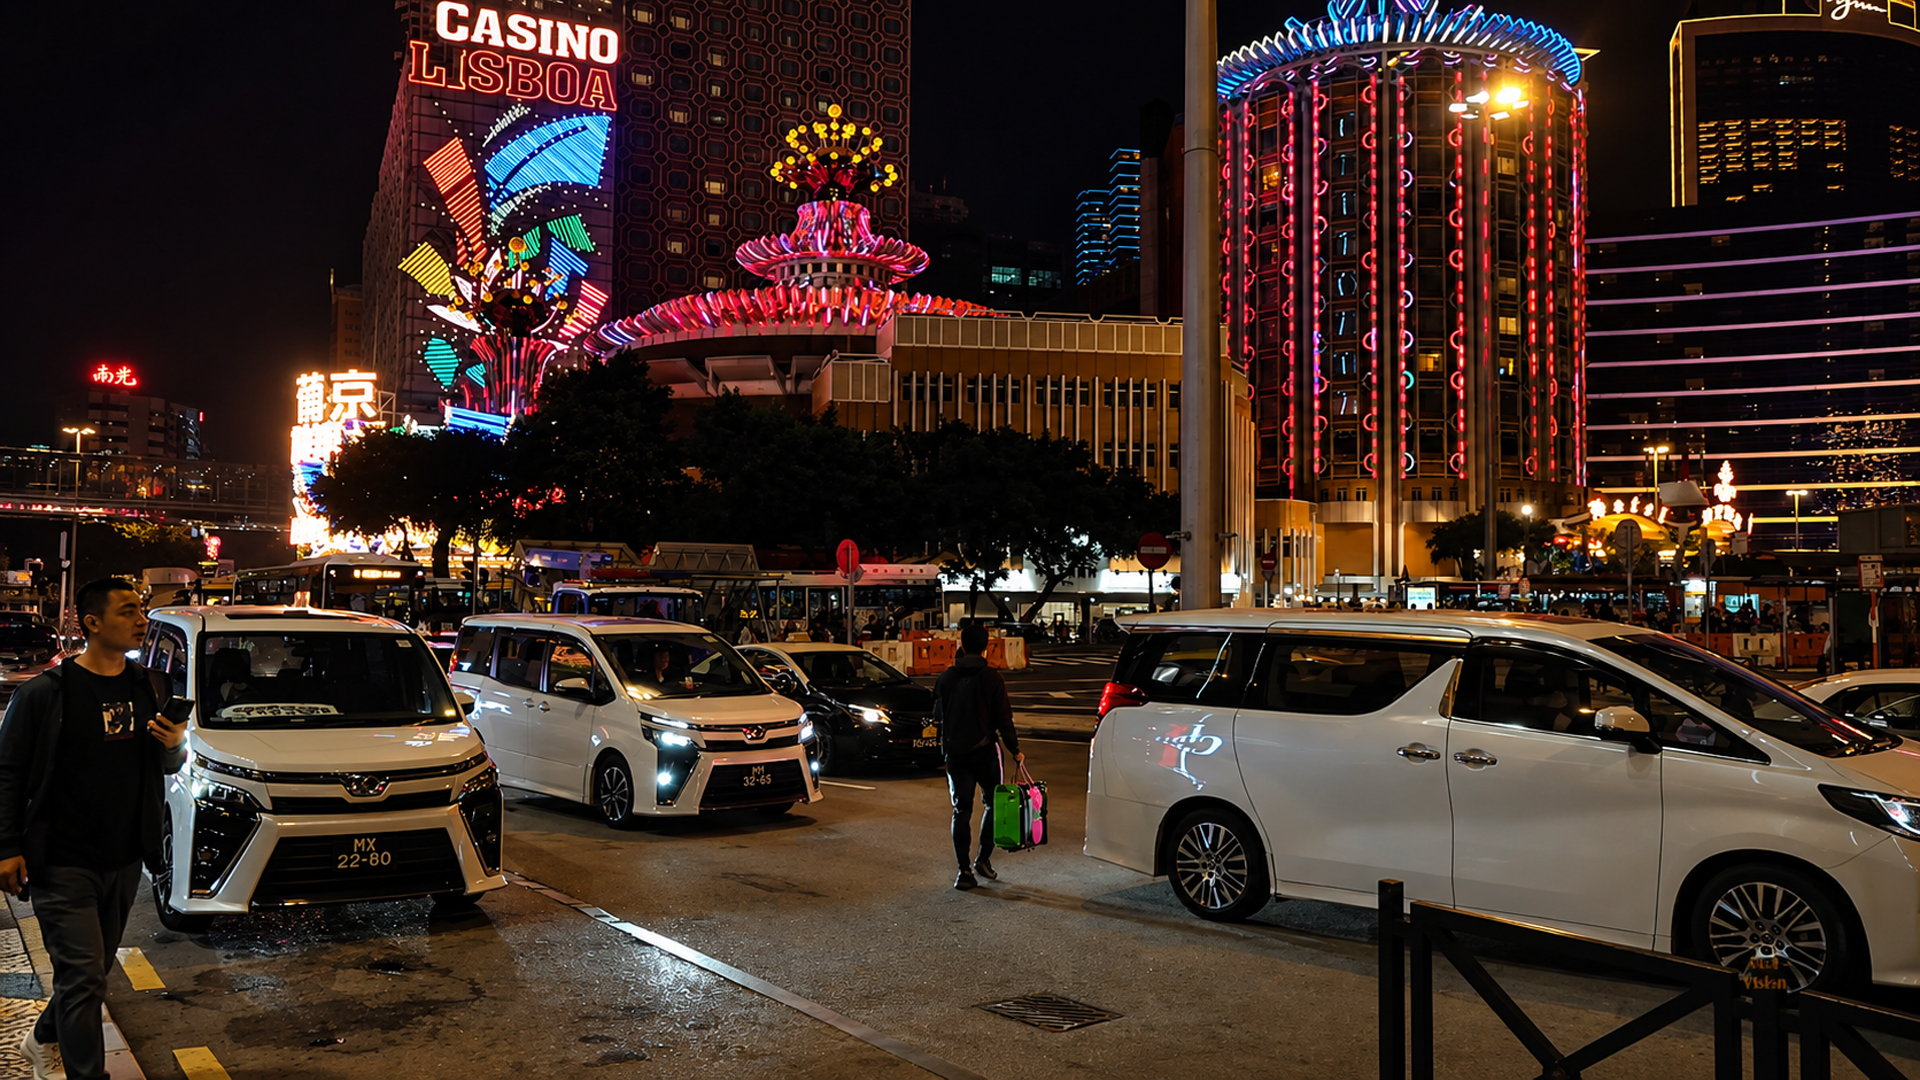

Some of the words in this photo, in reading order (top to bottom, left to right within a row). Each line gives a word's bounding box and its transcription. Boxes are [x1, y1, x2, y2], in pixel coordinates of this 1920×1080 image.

[435, 0, 620, 65] CASINO
[408, 40, 618, 112] LISBOA
[337, 851, 392, 869] 22-80
[353, 837, 377, 852] MX
